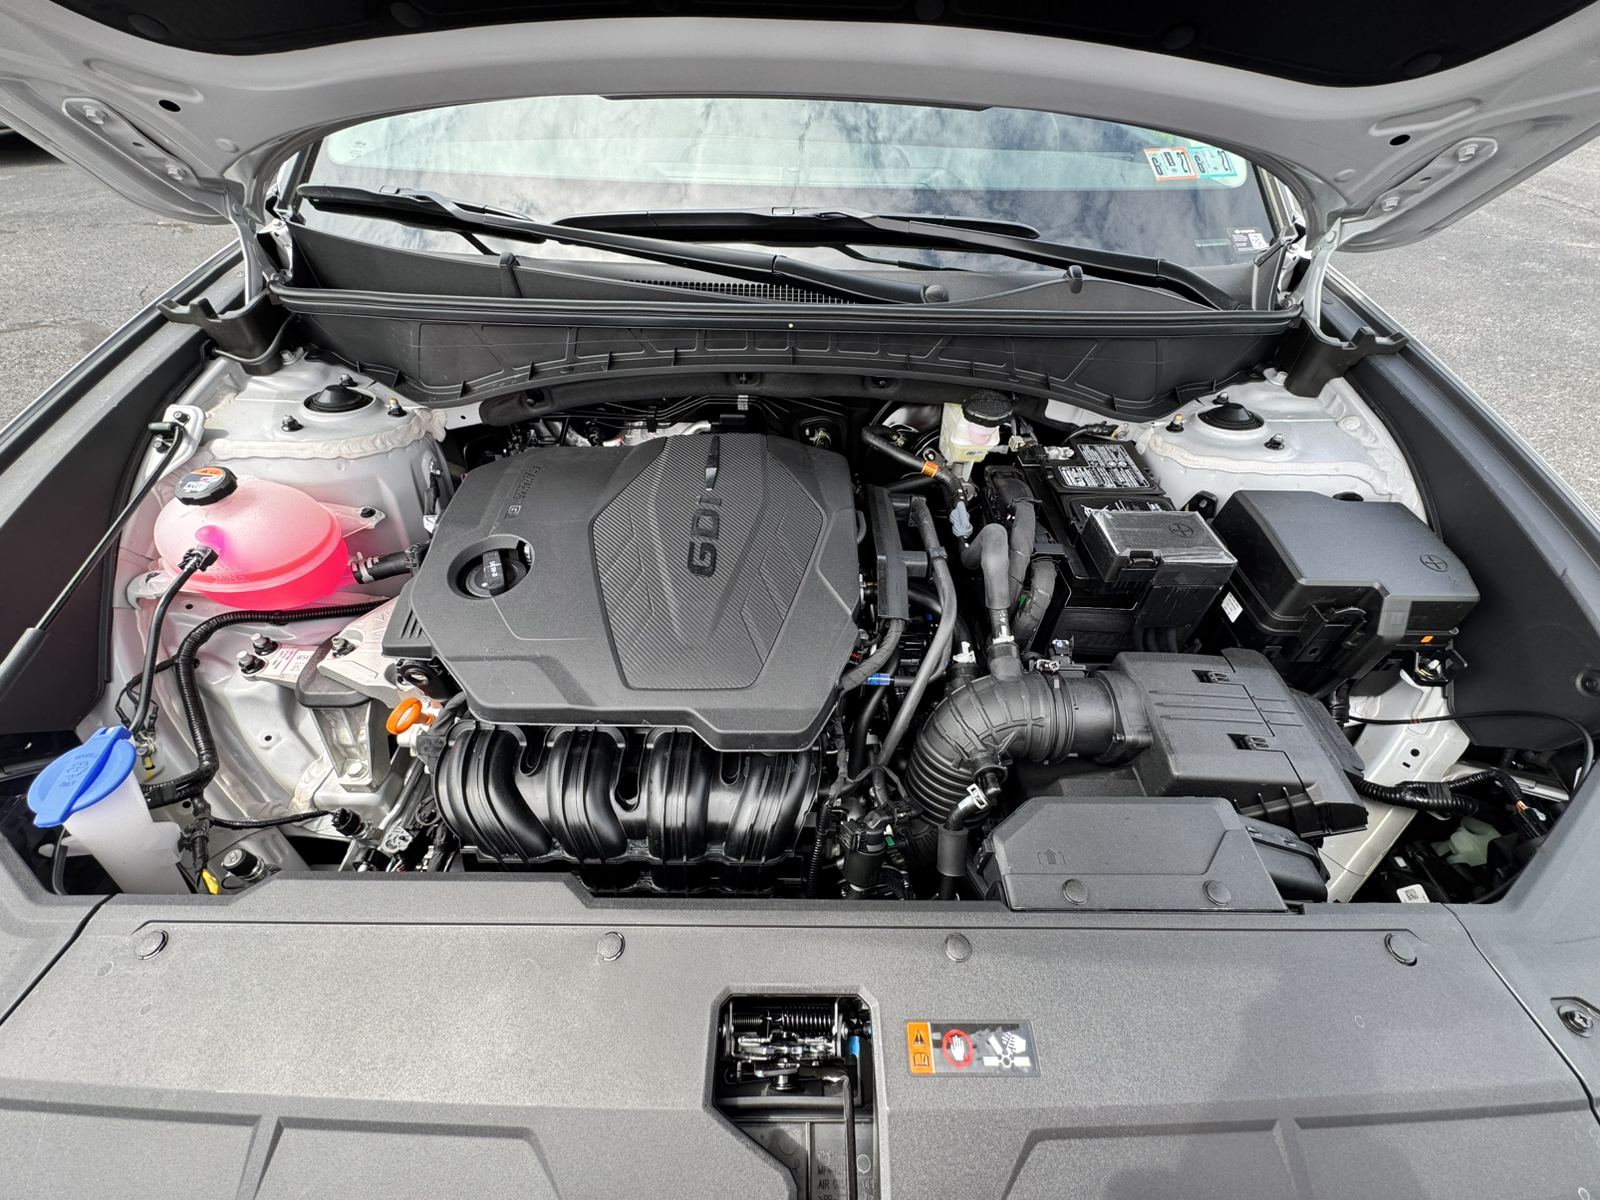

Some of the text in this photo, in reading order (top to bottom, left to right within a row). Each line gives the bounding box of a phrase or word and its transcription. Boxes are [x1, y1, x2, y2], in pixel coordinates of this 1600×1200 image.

[1151, 156, 1164, 176] 6
[1176, 151, 1193, 174] 27
[1194, 150, 1233, 174] 6 27
